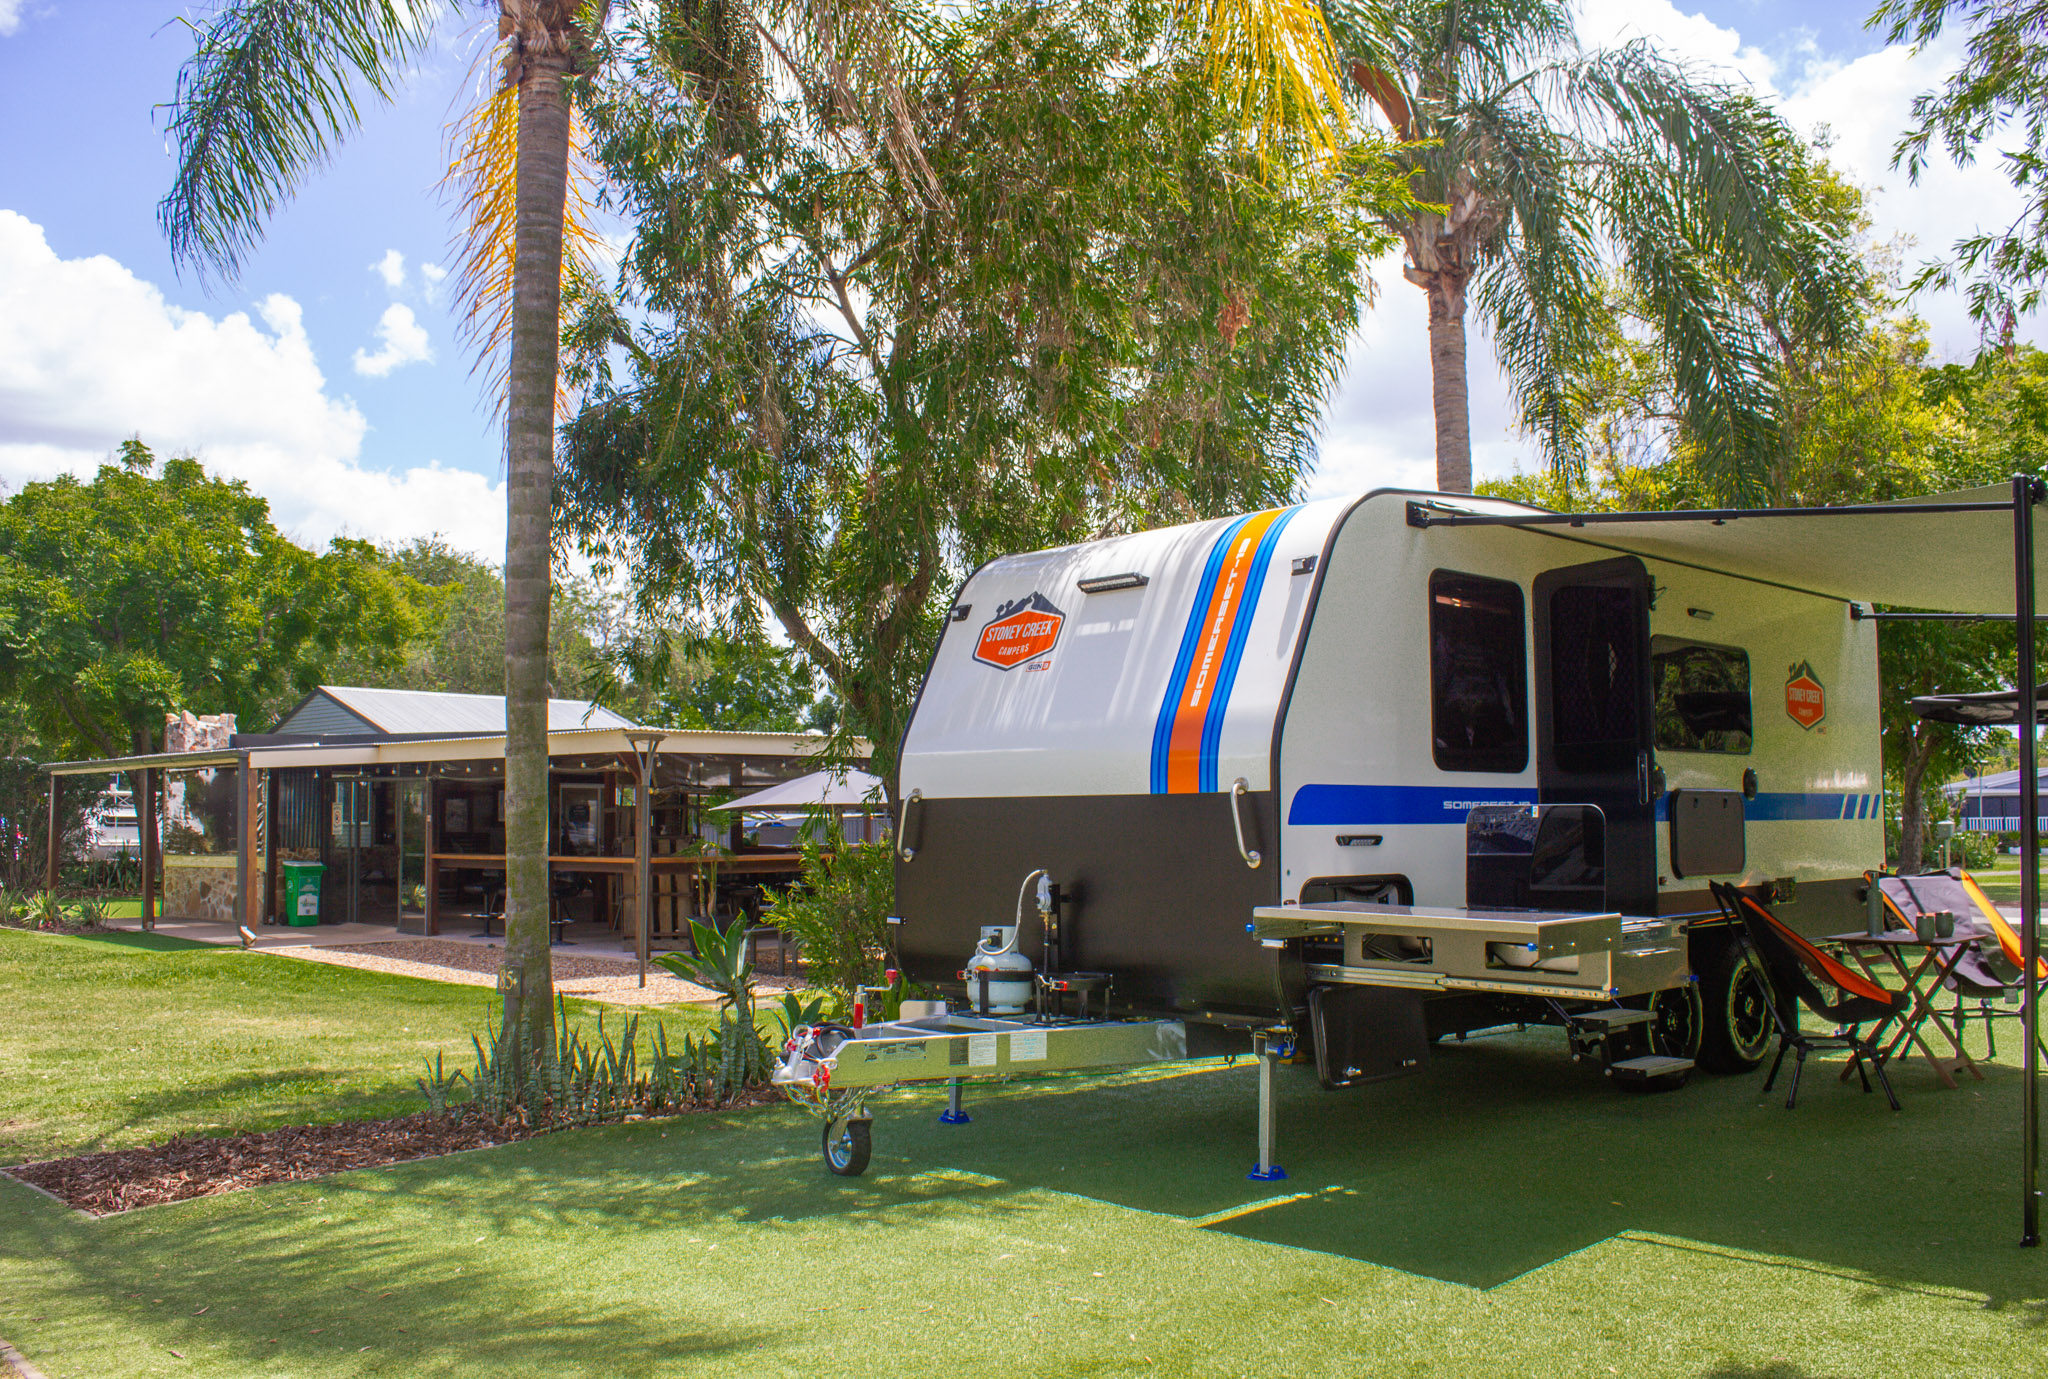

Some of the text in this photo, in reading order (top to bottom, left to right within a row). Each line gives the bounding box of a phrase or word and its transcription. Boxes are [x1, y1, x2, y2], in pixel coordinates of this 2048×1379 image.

[986, 620, 1055, 642] STONEY CREEK
[998, 643, 1029, 655] CAMPERS
[499, 969, 513, 990] 85
